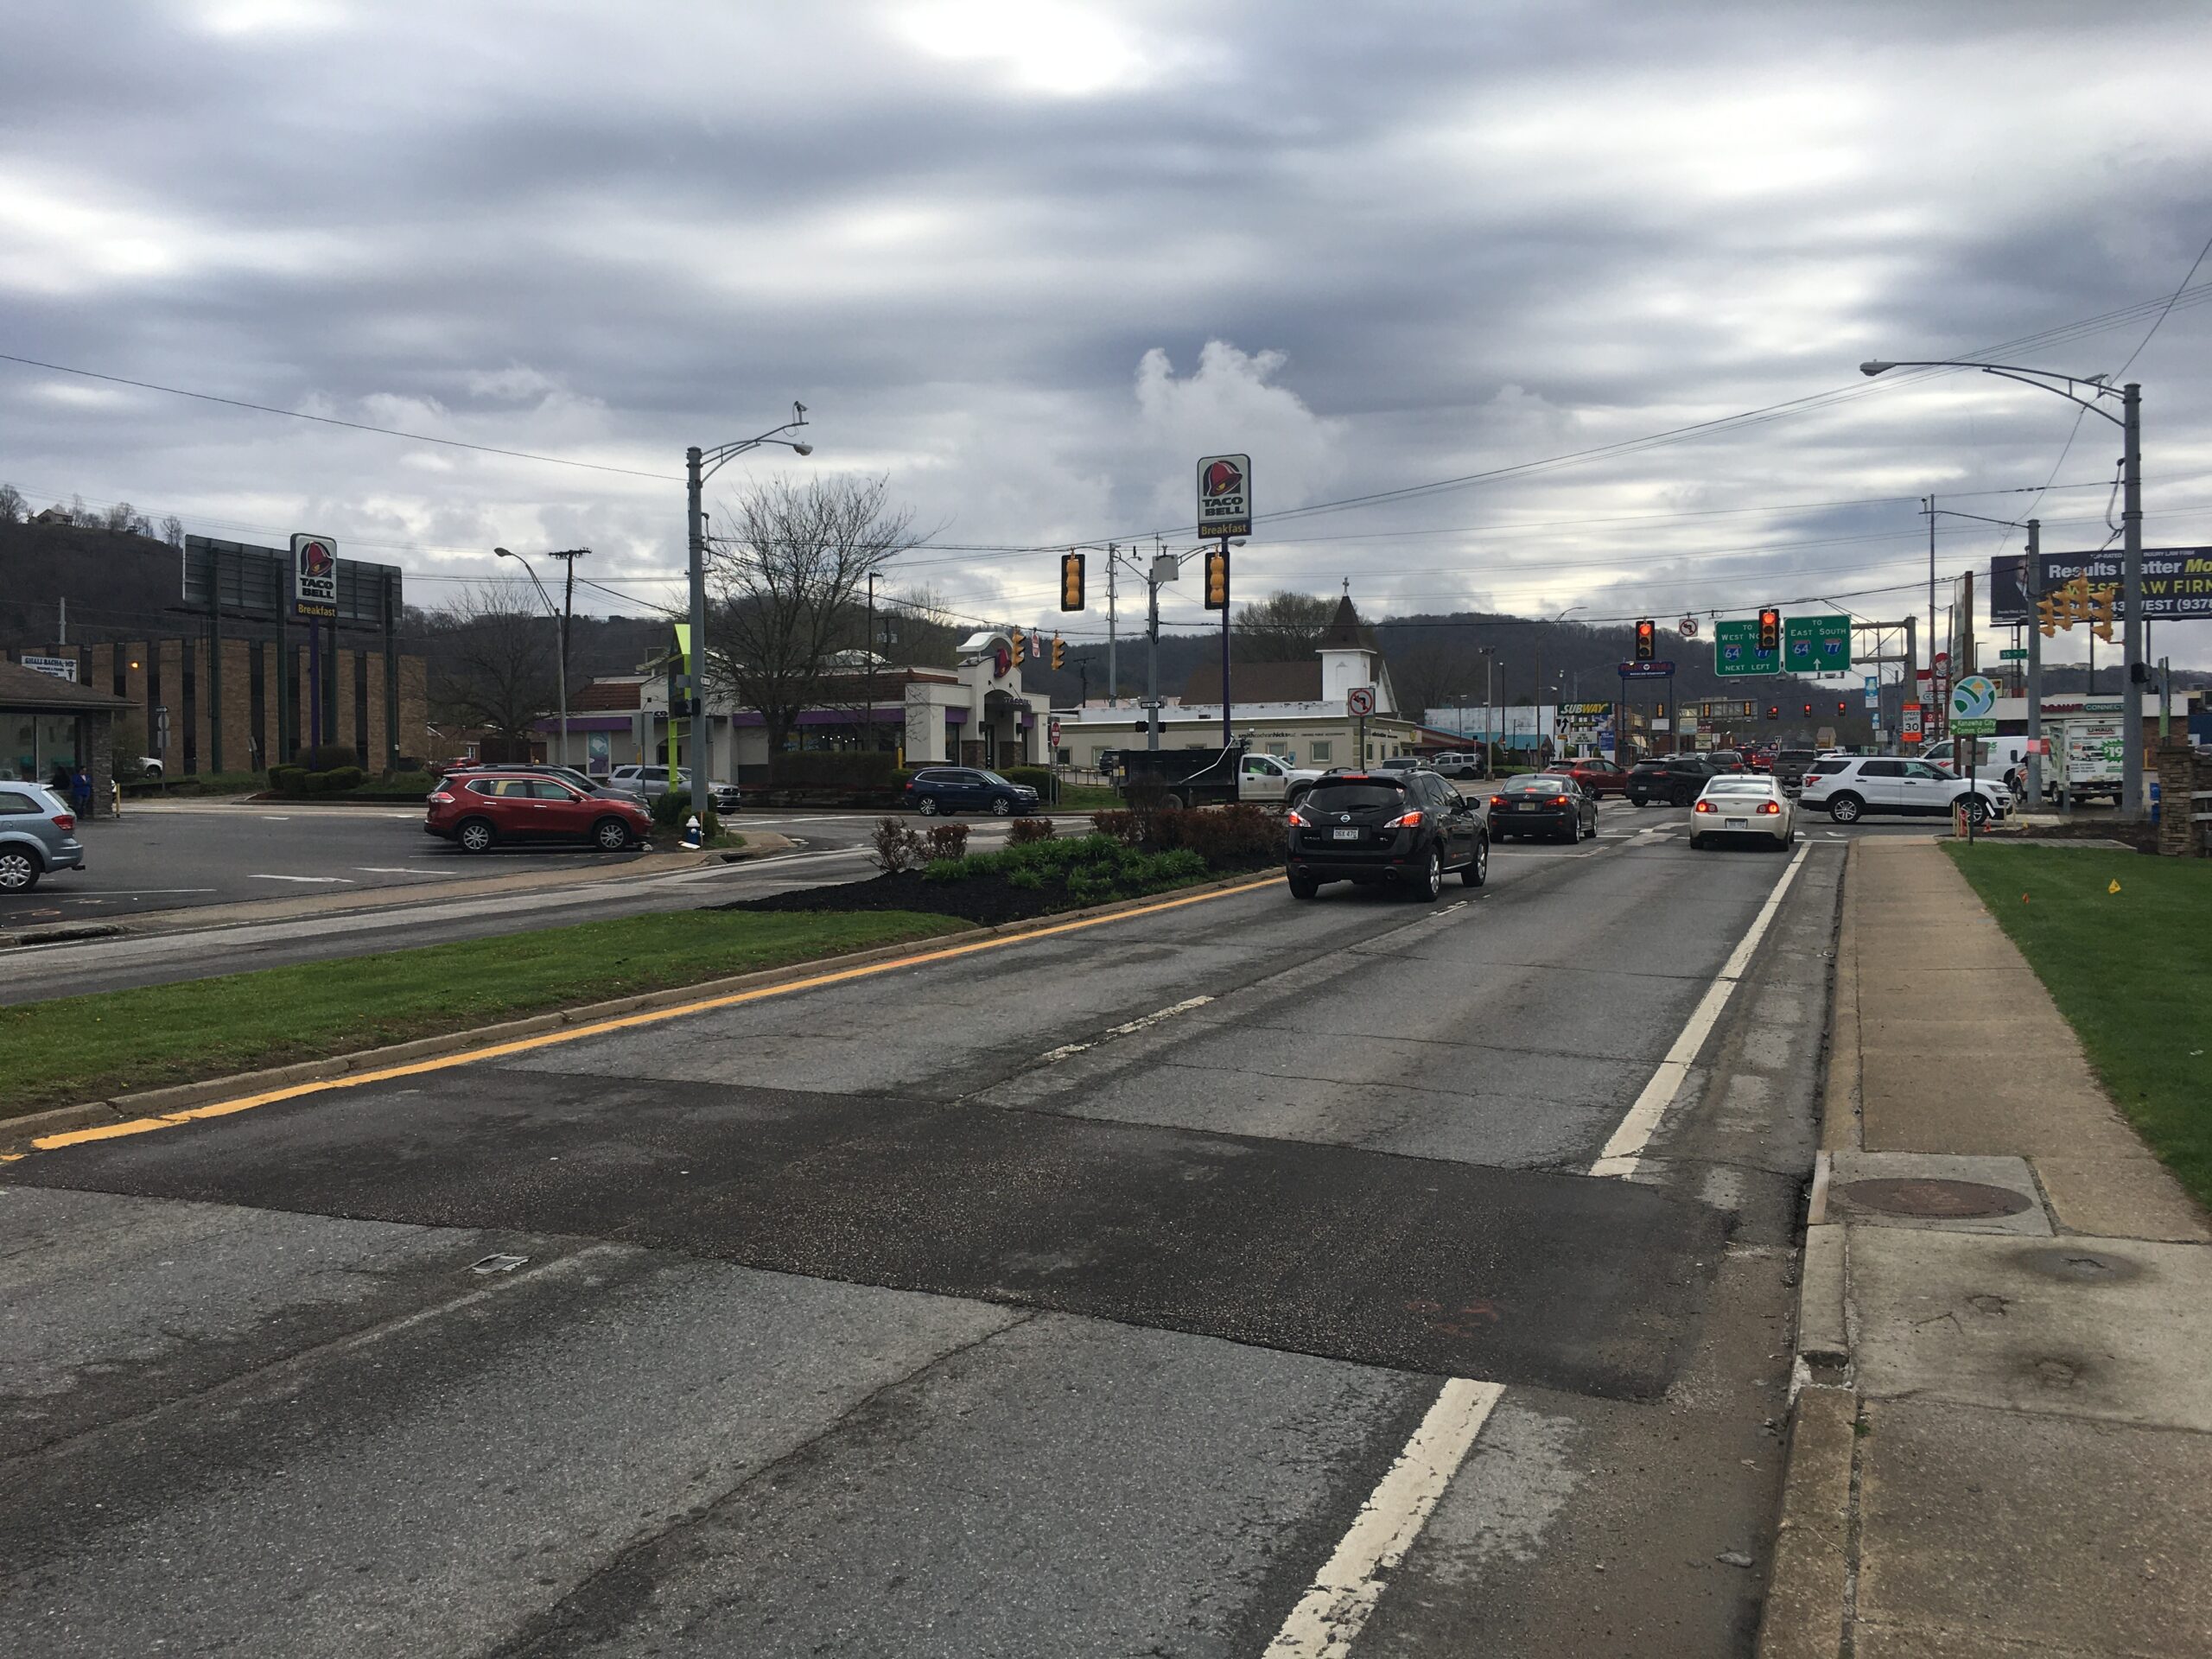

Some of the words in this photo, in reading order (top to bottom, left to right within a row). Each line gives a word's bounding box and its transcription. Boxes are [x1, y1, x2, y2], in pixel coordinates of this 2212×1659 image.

[1202, 497, 1243, 507] TACO
[1205, 506, 1244, 517] BELL
[1201, 524, 1247, 536] Breakfast
[2049, 562, 2117, 578] Results
[2120, 561, 2182, 575] atter
[300, 577, 334, 589] TACO
[2140, 581, 2167, 594] AW
[302, 588, 334, 600] BELL
[298, 603, 336, 617] Breakfast
[1725, 647, 1740, 658] 64
[1794, 644, 1809, 654] 64
[1825, 643, 1840, 653] 77
[1560, 702, 1609, 715] SUBWAY
[1904, 723, 1919, 732] 30
